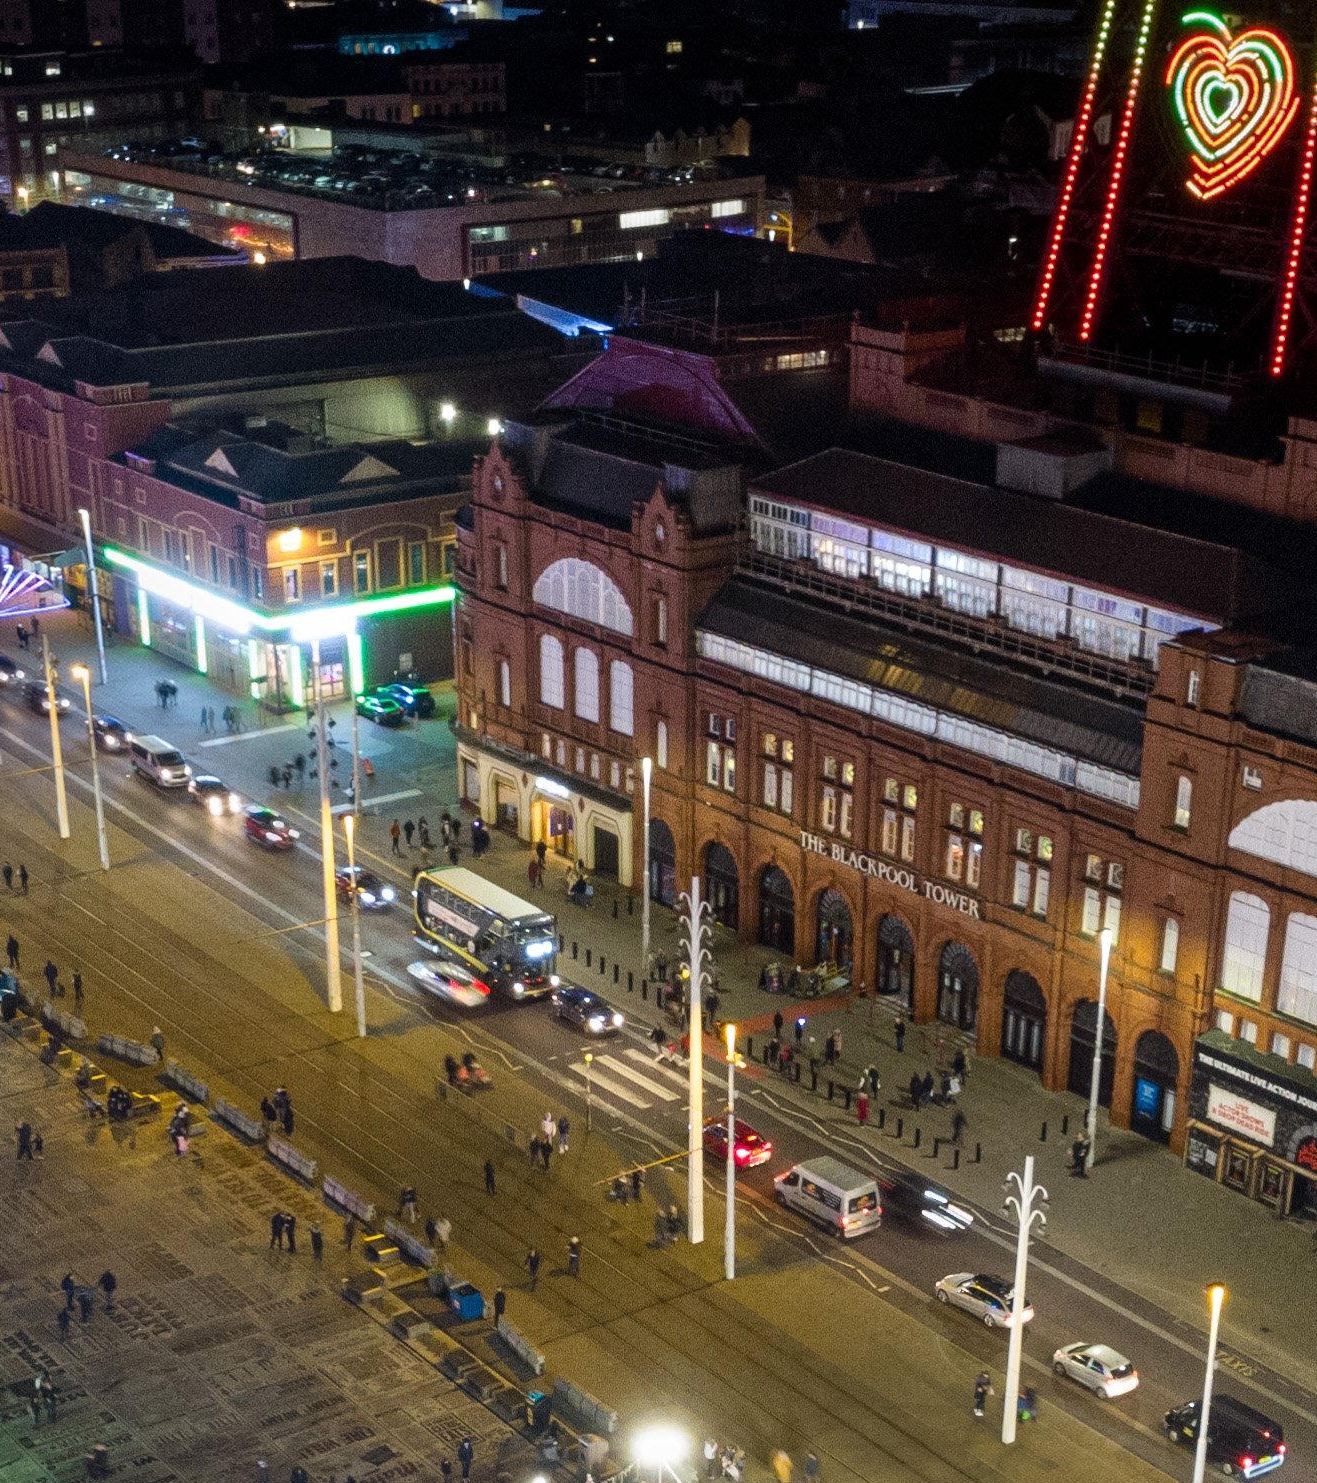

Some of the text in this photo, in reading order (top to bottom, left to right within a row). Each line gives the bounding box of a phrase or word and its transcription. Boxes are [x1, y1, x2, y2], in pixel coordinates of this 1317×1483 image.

[800, 830, 981, 919] THE BLACKPOOL TOWER
[1198, 1052, 1213, 1066] THE
[1213, 1058, 1250, 1081] ULTIMATE
[1250, 1074, 1268, 1089] LIVE
[1268, 1081, 1297, 1102] ACTION
[1215, 1351, 1259, 1378] TAXIS
